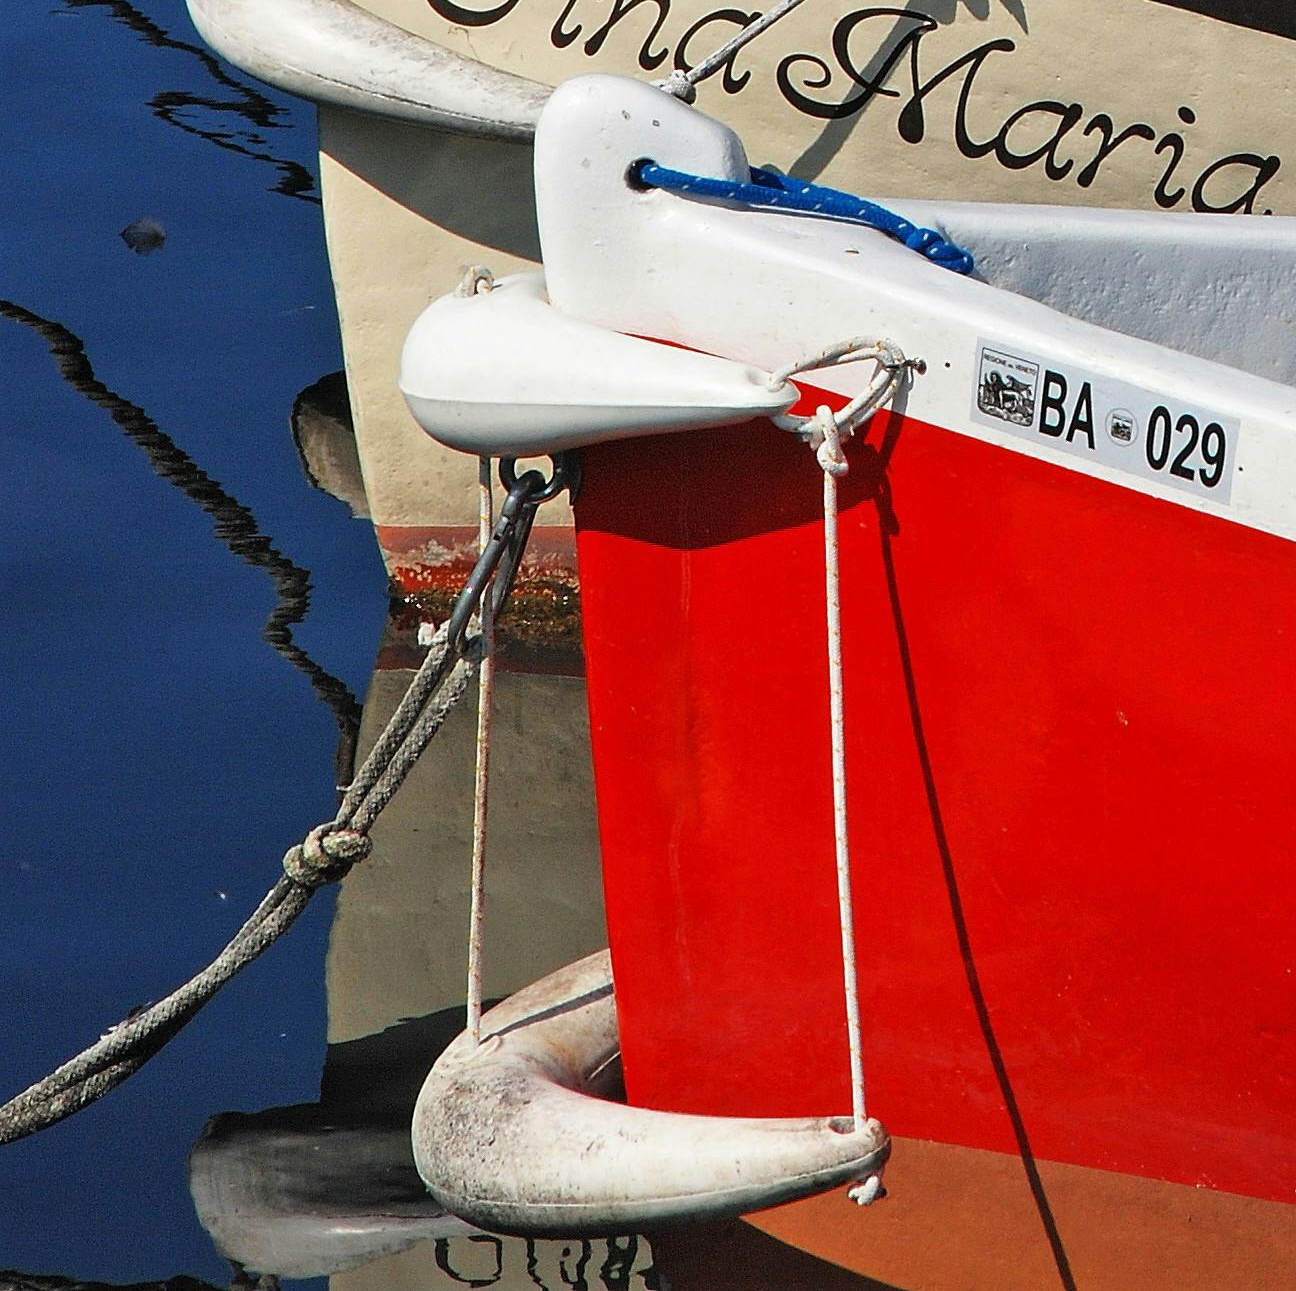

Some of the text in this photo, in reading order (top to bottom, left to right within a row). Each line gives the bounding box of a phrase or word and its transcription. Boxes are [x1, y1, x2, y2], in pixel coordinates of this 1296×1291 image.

[776, 7, 1281, 215] Maria
[1038, 369, 1226, 488] BA 029
